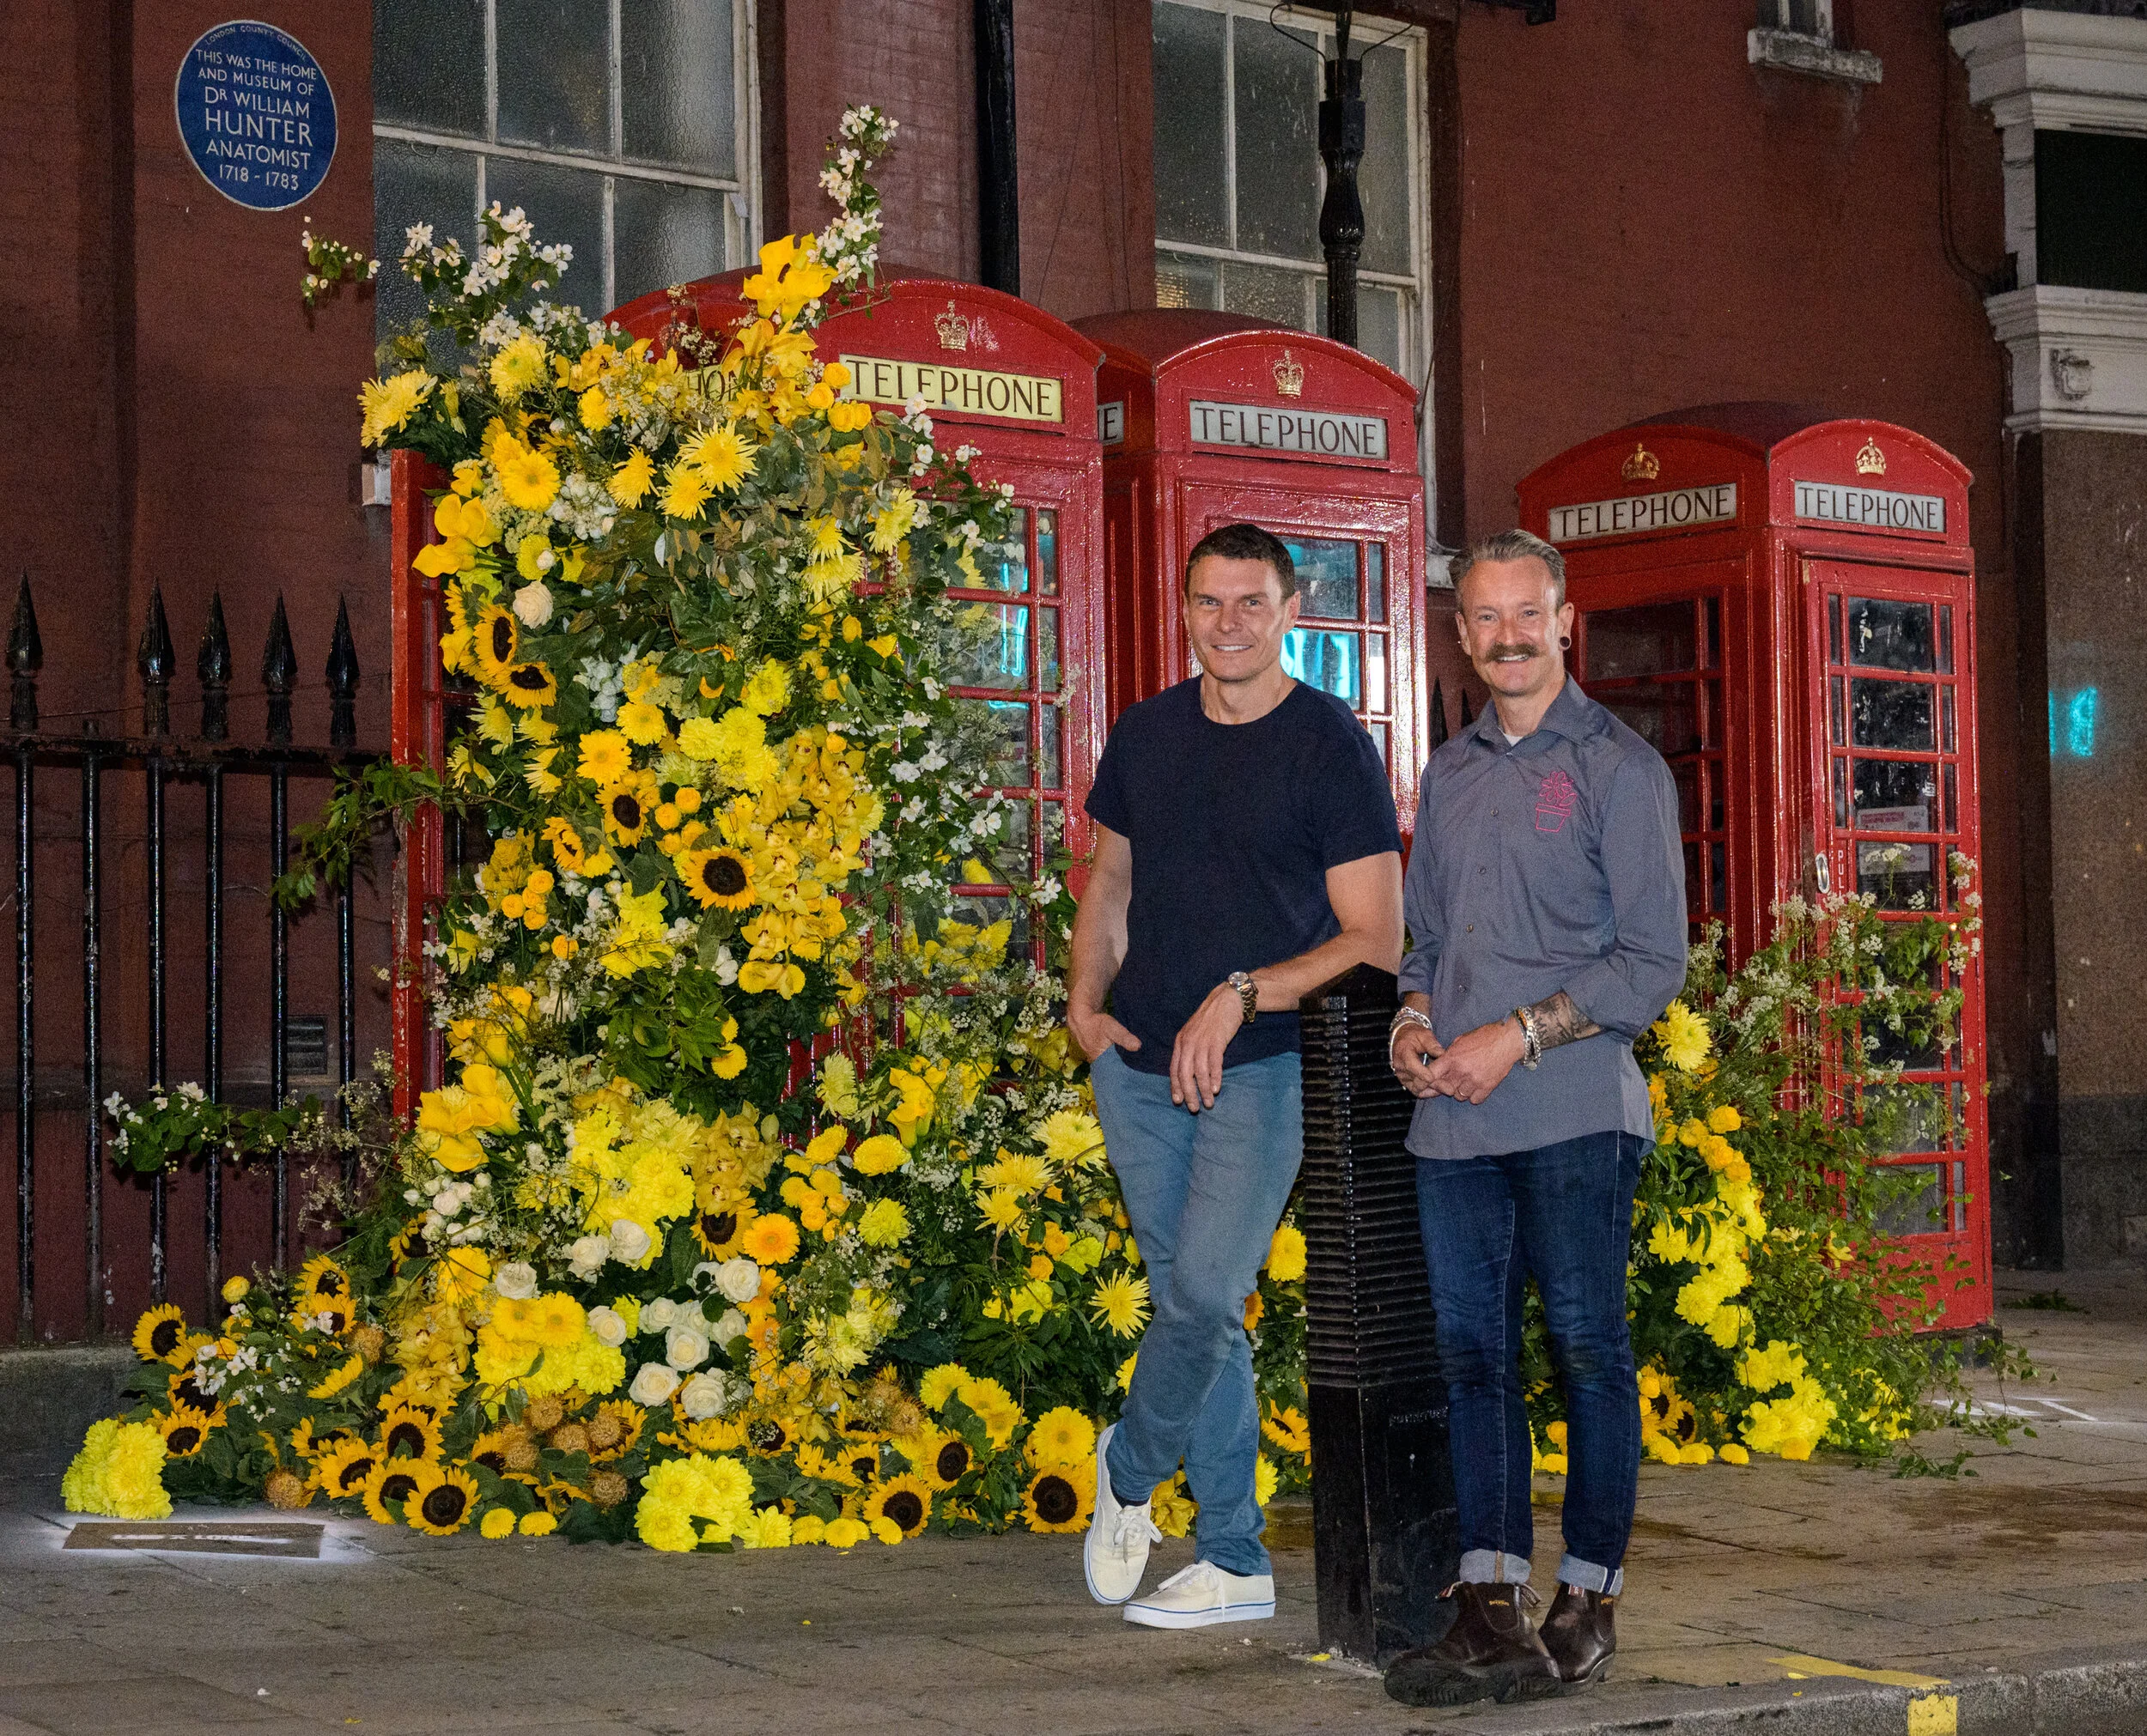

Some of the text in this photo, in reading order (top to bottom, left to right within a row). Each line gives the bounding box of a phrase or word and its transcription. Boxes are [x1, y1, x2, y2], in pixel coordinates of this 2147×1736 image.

[205, 25, 307, 62] LONDON COUNTY COUNCIL
[195, 49, 317, 80] THIS WAS THE HOME
[198, 67, 314, 96] AND MUSEUM OF
[233, 90, 309, 118] WILLIAM
[205, 107, 313, 147] HUNTER
[205, 139, 311, 170] ANATOMIST
[219, 164, 249, 182] 1718
[265, 171, 299, 191] 1783
[845, 357, 1054, 416] TELEPHONE
[1195, 406, 1378, 455] TELEPHONE
[1558, 486, 1731, 538] TELEPHONE
[1797, 486, 1938, 530] TELEPHONE
